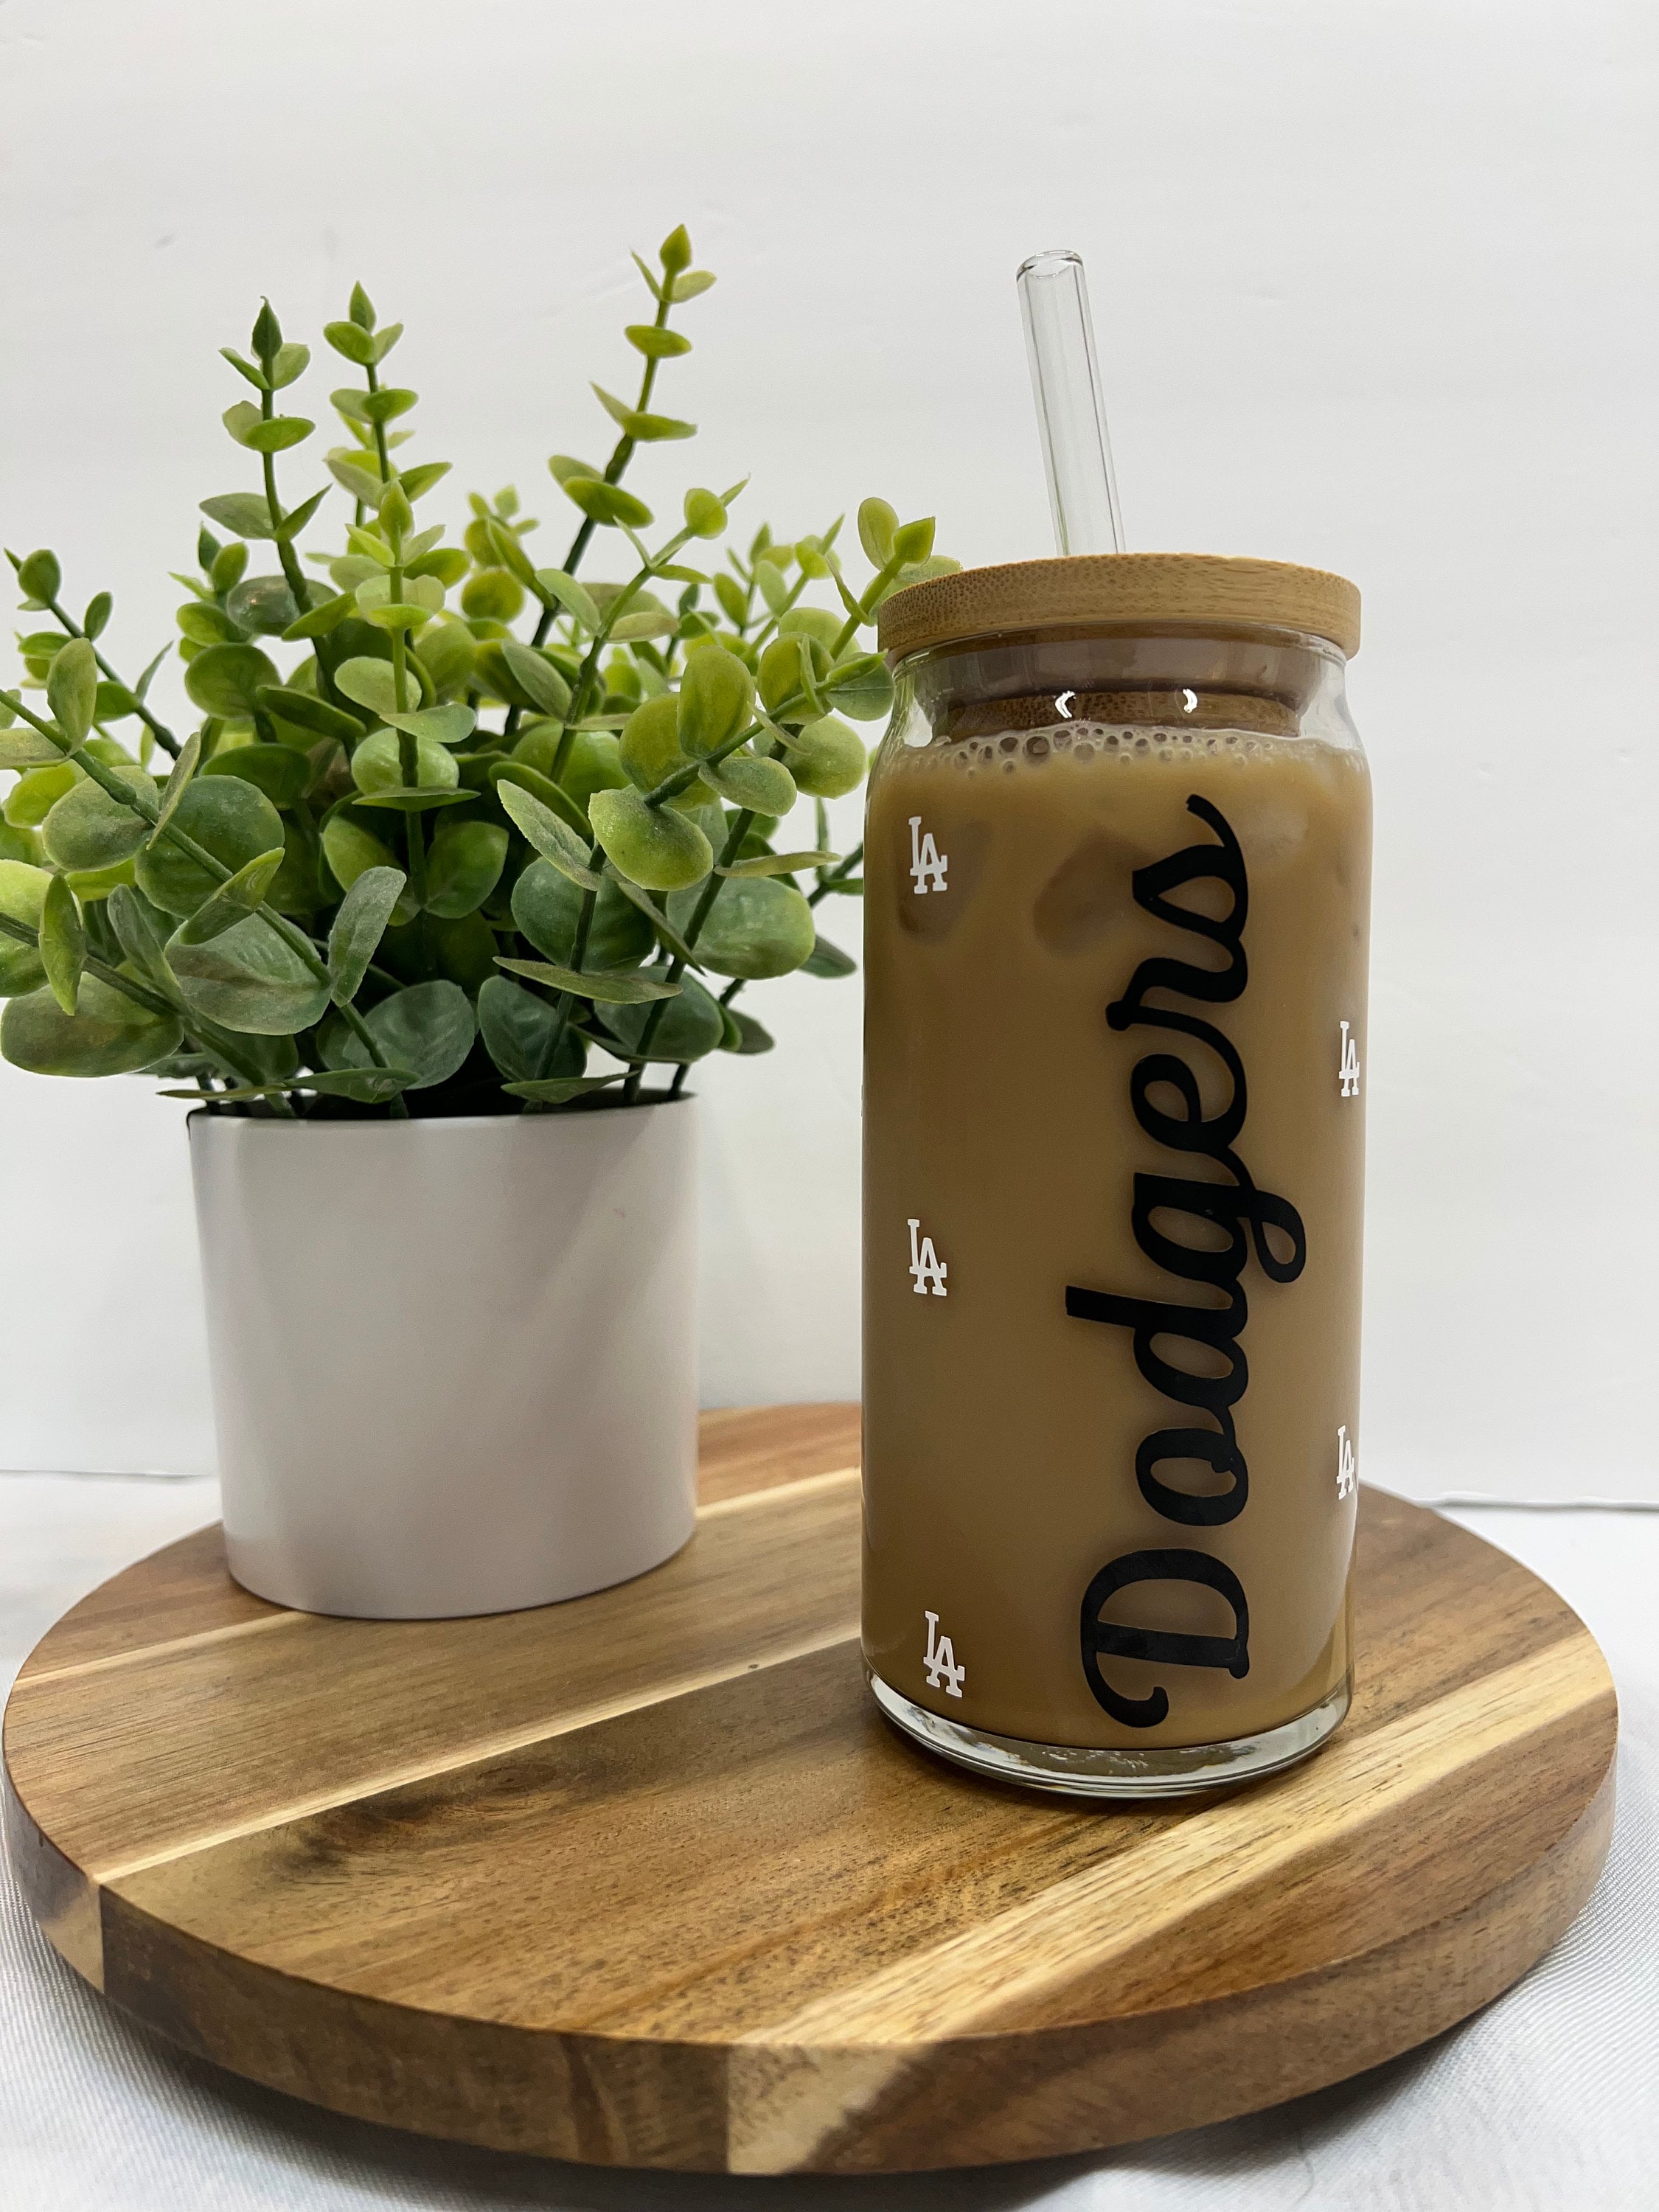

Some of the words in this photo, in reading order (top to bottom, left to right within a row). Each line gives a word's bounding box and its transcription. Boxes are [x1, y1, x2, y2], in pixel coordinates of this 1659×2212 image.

[908, 816, 947, 894] LA
[1338, 1020, 1360, 1097] LA
[907, 1218, 947, 1296] LA
[1065, 793, 1307, 1728] Dodgers
[1336, 1425, 1354, 1500] LA
[923, 1610, 965, 1697] LA
